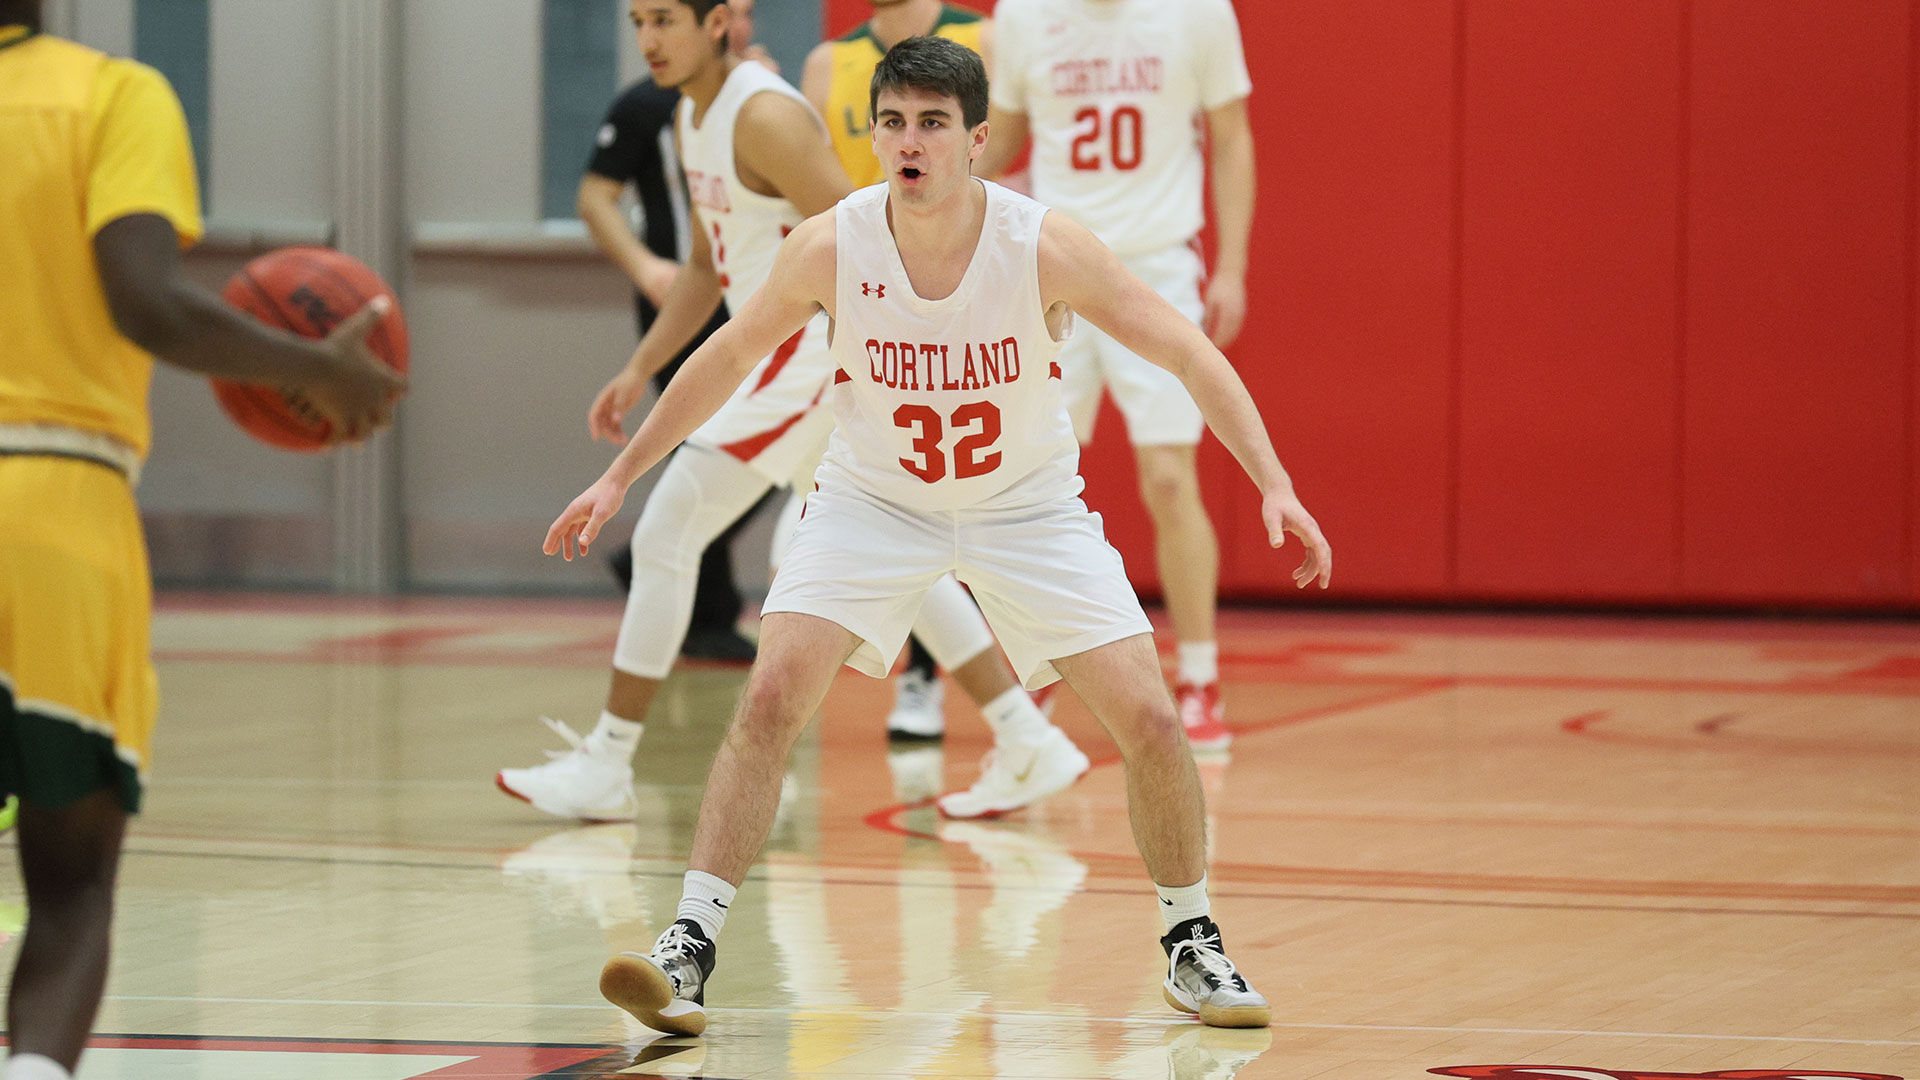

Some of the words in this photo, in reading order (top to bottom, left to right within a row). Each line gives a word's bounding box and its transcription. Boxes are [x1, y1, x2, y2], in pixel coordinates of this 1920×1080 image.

[1071, 106, 1143, 172] 20
[865, 336, 1021, 392] CORTLAND
[892, 400, 1003, 485] 32
